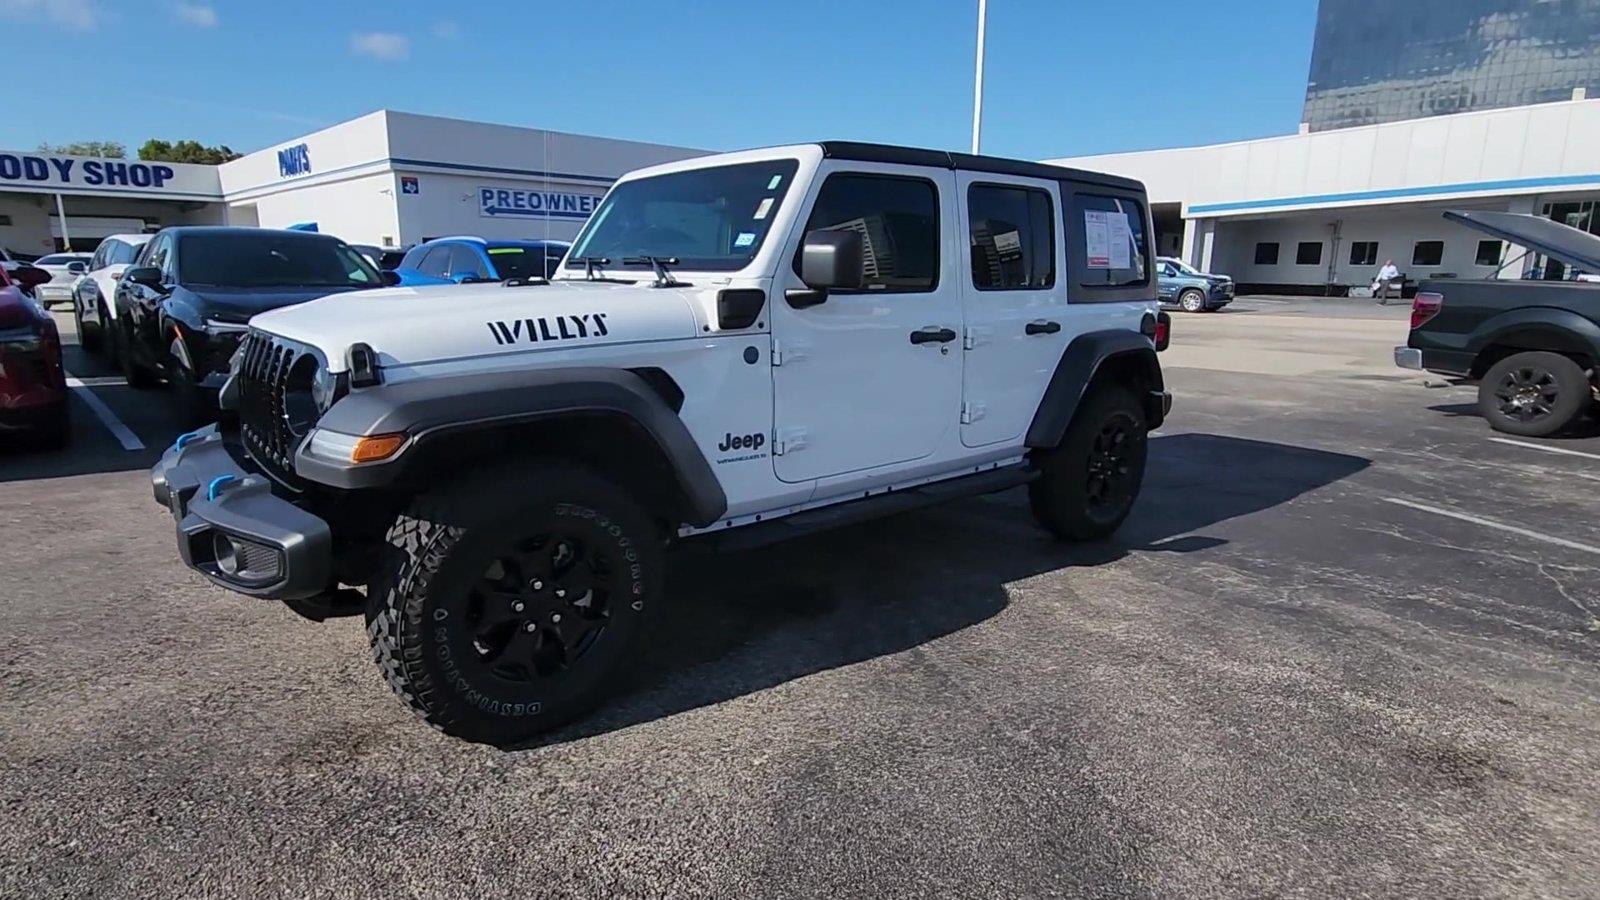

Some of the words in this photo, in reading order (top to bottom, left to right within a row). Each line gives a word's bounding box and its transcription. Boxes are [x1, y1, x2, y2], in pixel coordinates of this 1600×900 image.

[83, 161, 173, 188] SHOP
[278, 143, 311, 177] PARTS
[487, 313, 608, 345] WILLYS
[718, 432, 765, 452] Jeep
